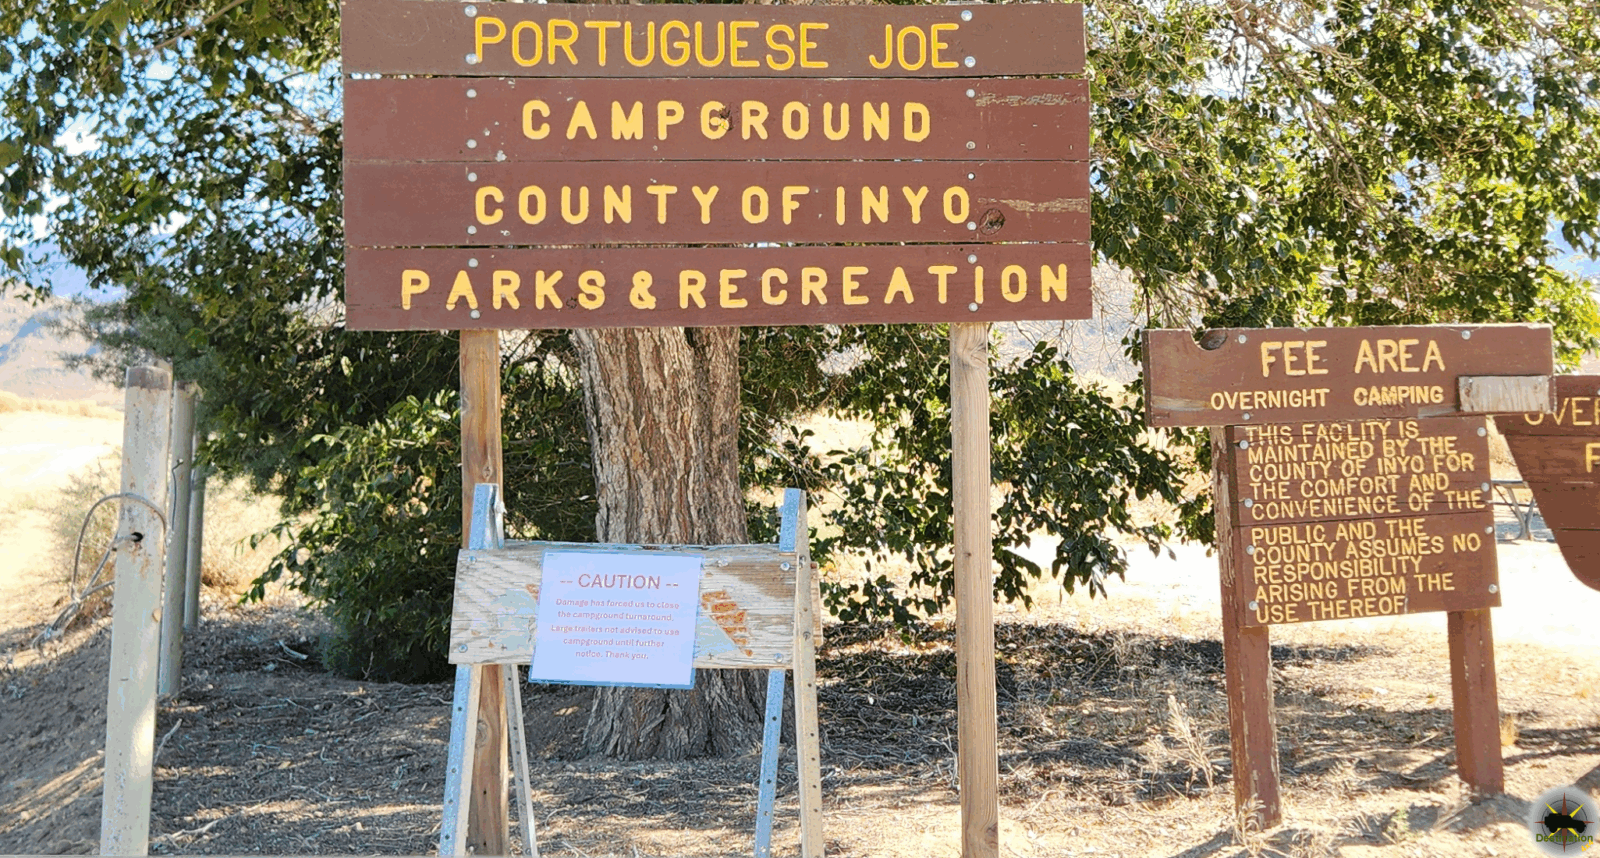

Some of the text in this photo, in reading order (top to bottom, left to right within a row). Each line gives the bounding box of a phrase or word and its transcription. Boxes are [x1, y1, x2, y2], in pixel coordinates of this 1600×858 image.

[475, 16, 960, 71] PORTUGUESE JOE
[522, 99, 931, 143] CAMPGROUND
[475, 185, 970, 226] COUNTY OF INYO
[401, 263, 1068, 311] PARKS & RECREATION
[1260, 339, 1446, 378] FEE AREA
[1210, 385, 1444, 410] OVERNIGHT CAMPING
[1246, 425, 1293, 445] THIS
[1399, 421, 1420, 440] IS
[1248, 436, 1458, 464] MAINTAINED BY THE
[1250, 452, 1475, 482] COUNTY OF INYO FOR
[1250, 473, 1449, 500] THE COMFORT AND
[1251, 490, 1486, 521] CONVENIENCE OF THE
[1251, 518, 1427, 546] PUBLIC AND THE
[1253, 533, 1481, 565] COUNTY ASSUMES NO
[578, 573, 660, 589] CAUTION
[1254, 555, 1423, 584] RESPONSIBILITY
[1255, 572, 1455, 604] ARISING FROM THE
[555, 598, 589, 608] Damage
[590, 599, 605, 607] has
[606, 600, 634, 608] forced
[572, 612, 624, 620] campground
[625, 613, 674, 621] turnaround.
[1255, 596, 1405, 624] USE THEREOF
[550, 625, 573, 633] Large
[574, 625, 603, 633] trailers
[653, 627, 663, 635] to
[563, 638, 614, 647] campground
[635, 639, 665, 647] further
[605, 650, 630, 658] Thank
